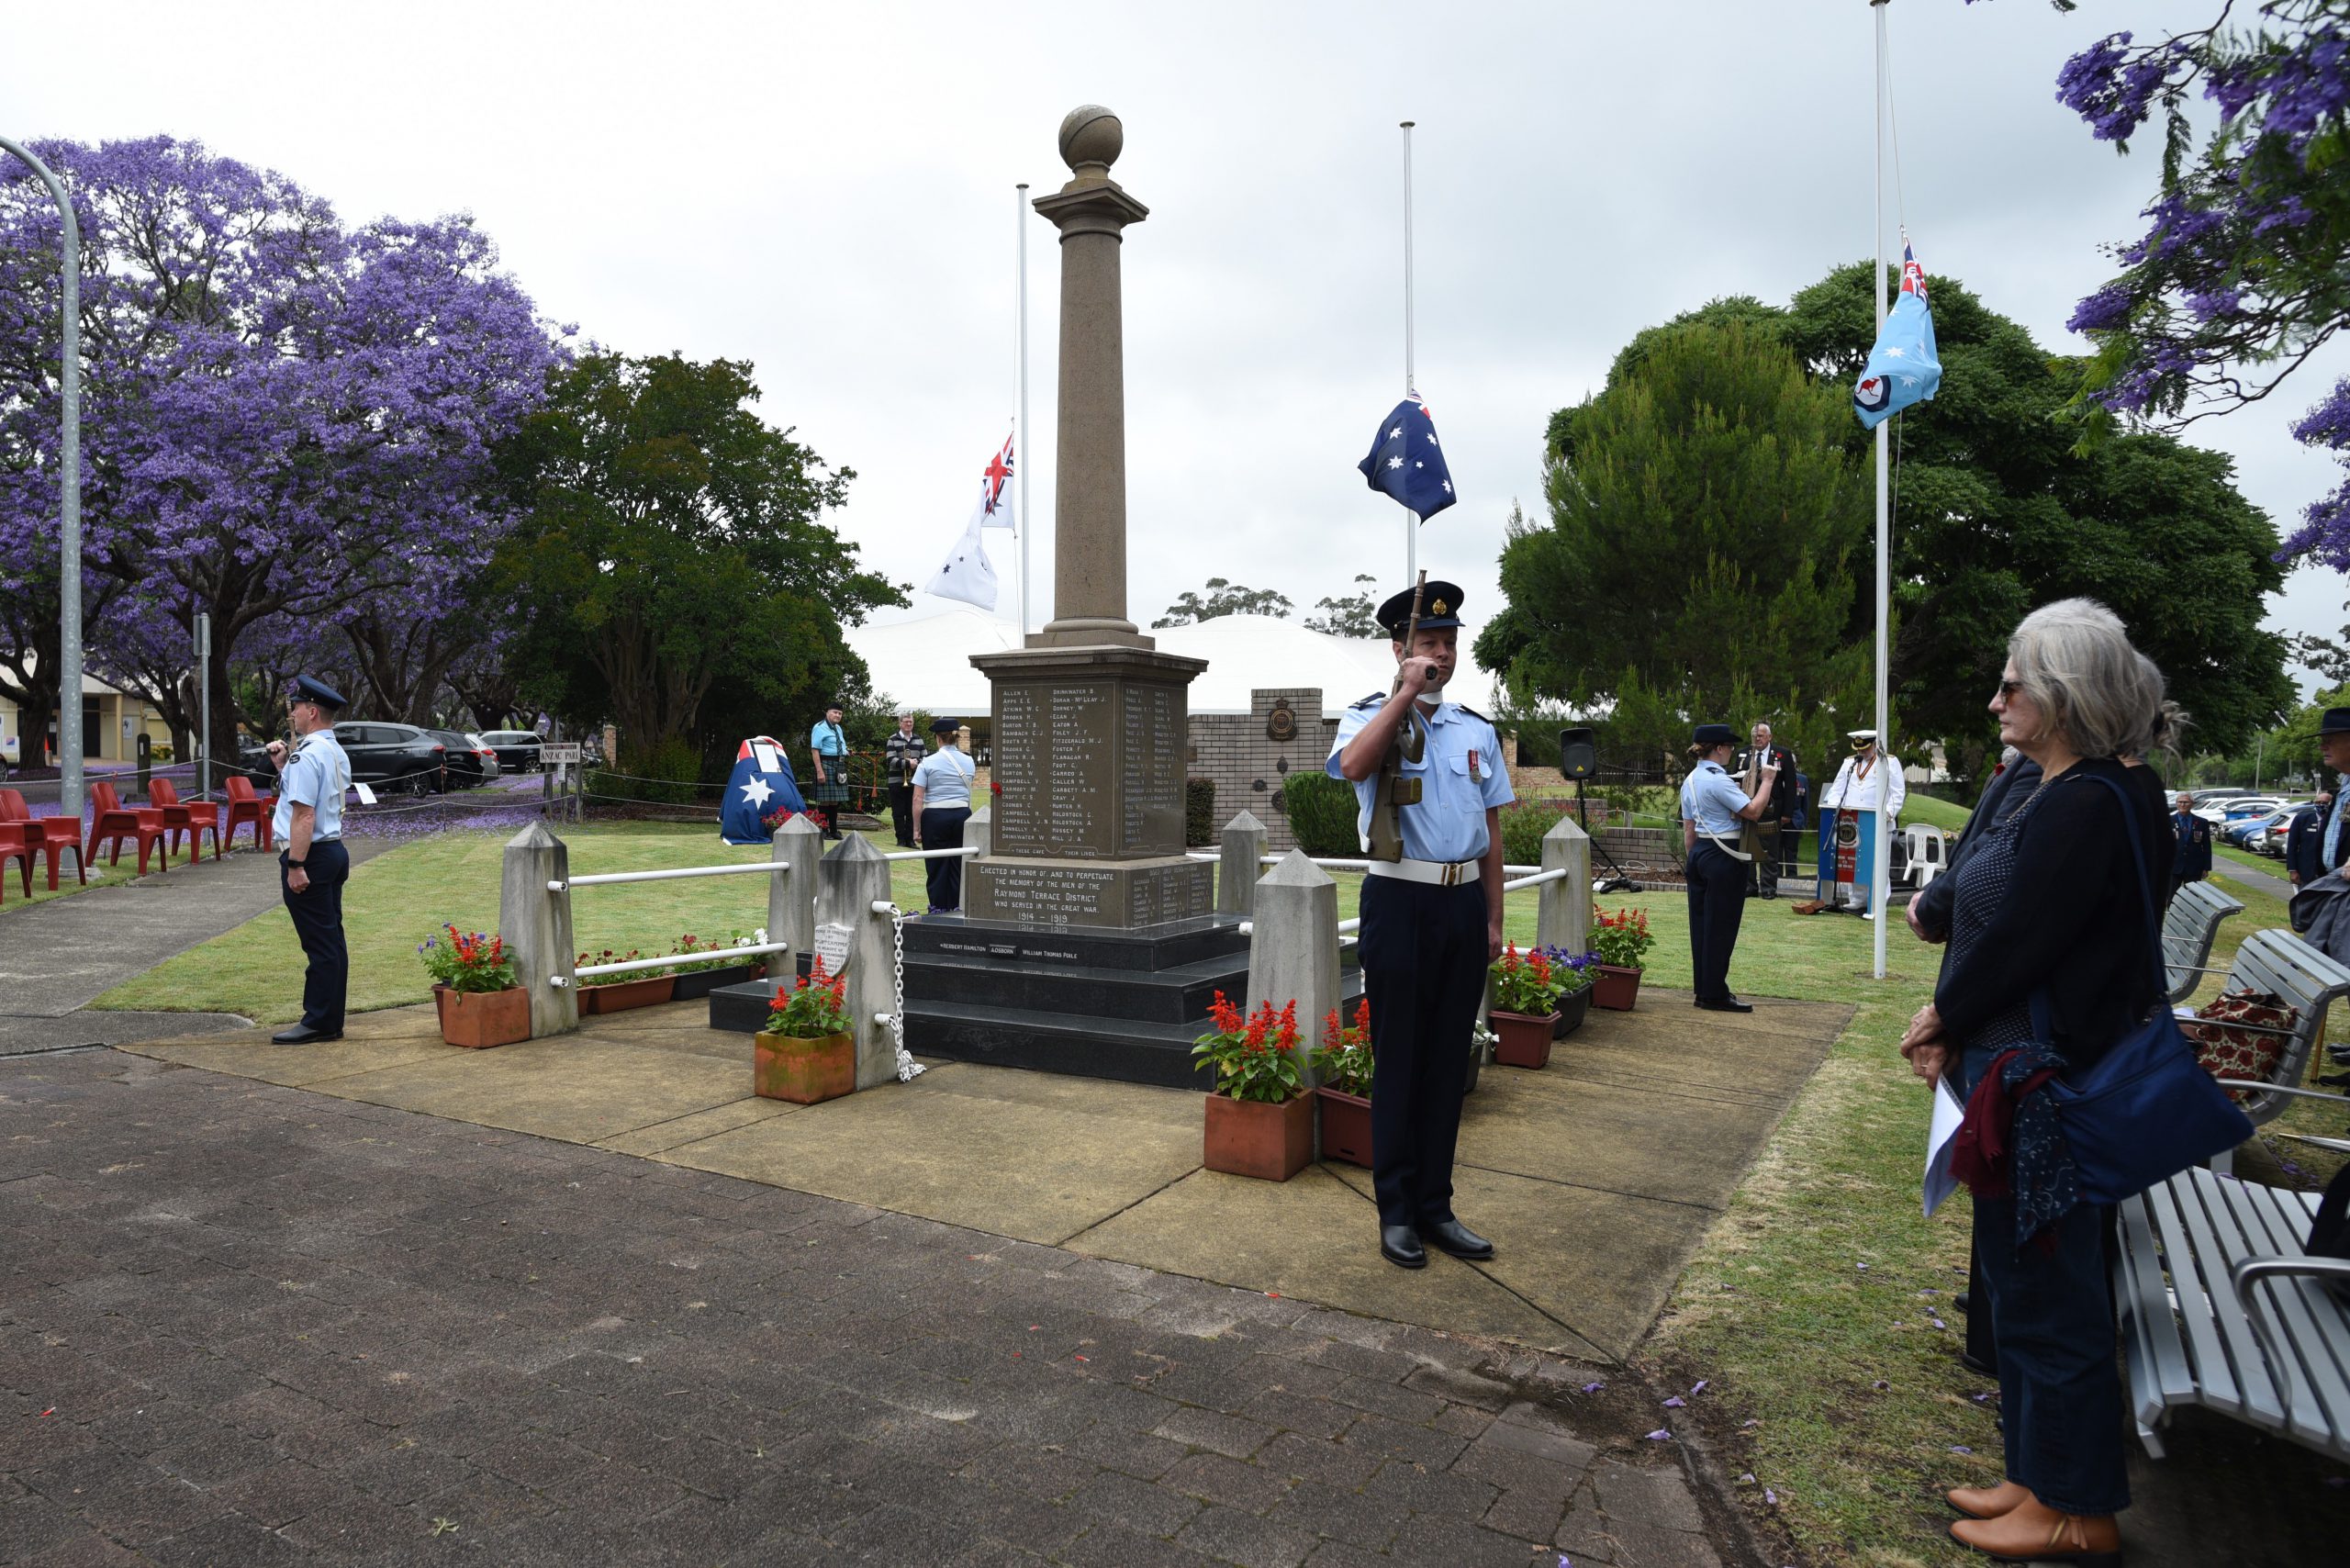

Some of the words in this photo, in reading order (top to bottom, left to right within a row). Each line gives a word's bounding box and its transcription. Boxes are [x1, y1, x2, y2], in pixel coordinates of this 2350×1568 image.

[979, 866, 1008, 875] ERECTED
[1076, 872, 1114, 880] PERPETUATE
[1009, 879, 1035, 887] MEMORY
[994, 888, 1026, 899] RAYMOND
[1031, 890, 1060, 901] TERRACE
[1018, 912, 1035, 921] 1914
[1050, 913, 1068, 924] 1919
